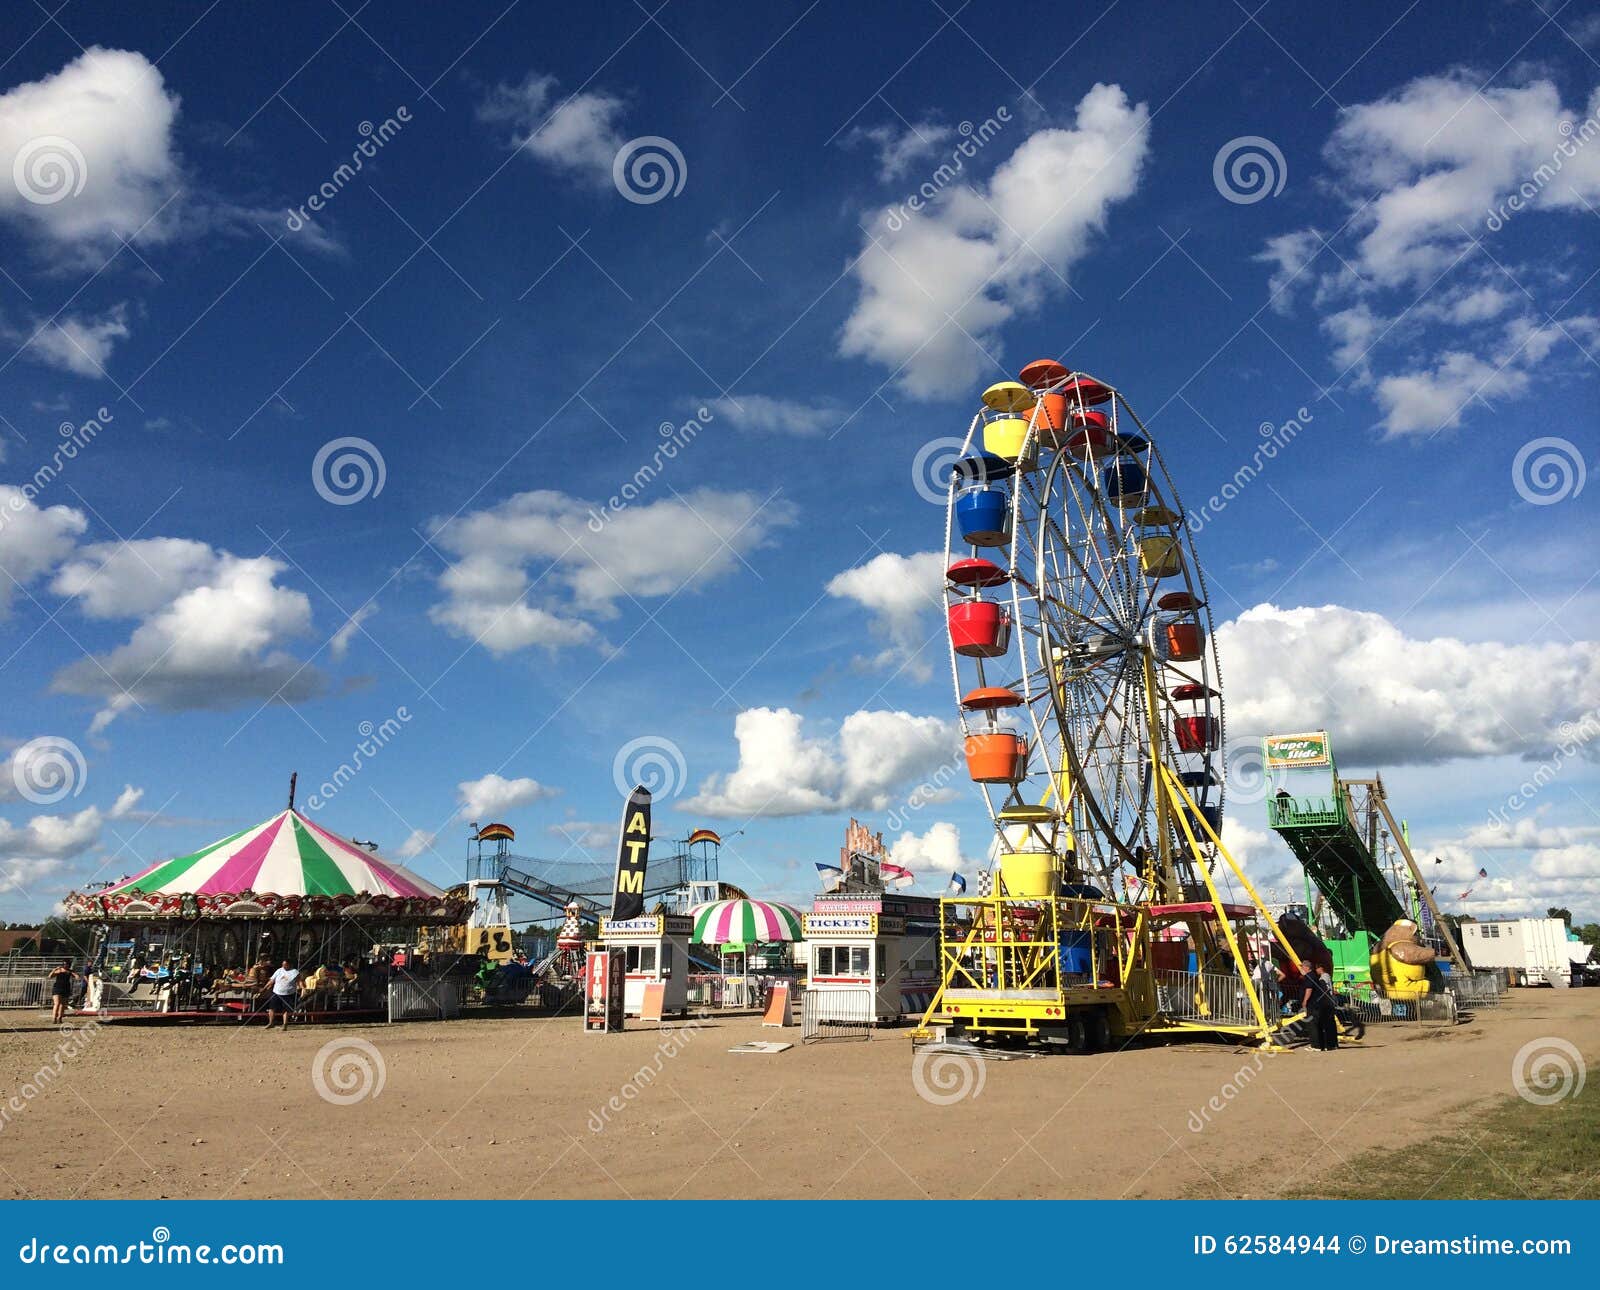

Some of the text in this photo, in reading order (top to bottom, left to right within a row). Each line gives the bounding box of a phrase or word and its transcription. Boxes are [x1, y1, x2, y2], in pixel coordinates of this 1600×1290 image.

[618, 811, 648, 895] ATM
[604, 920, 656, 929] TICKETS
[808, 919, 870, 927] TICKETS
